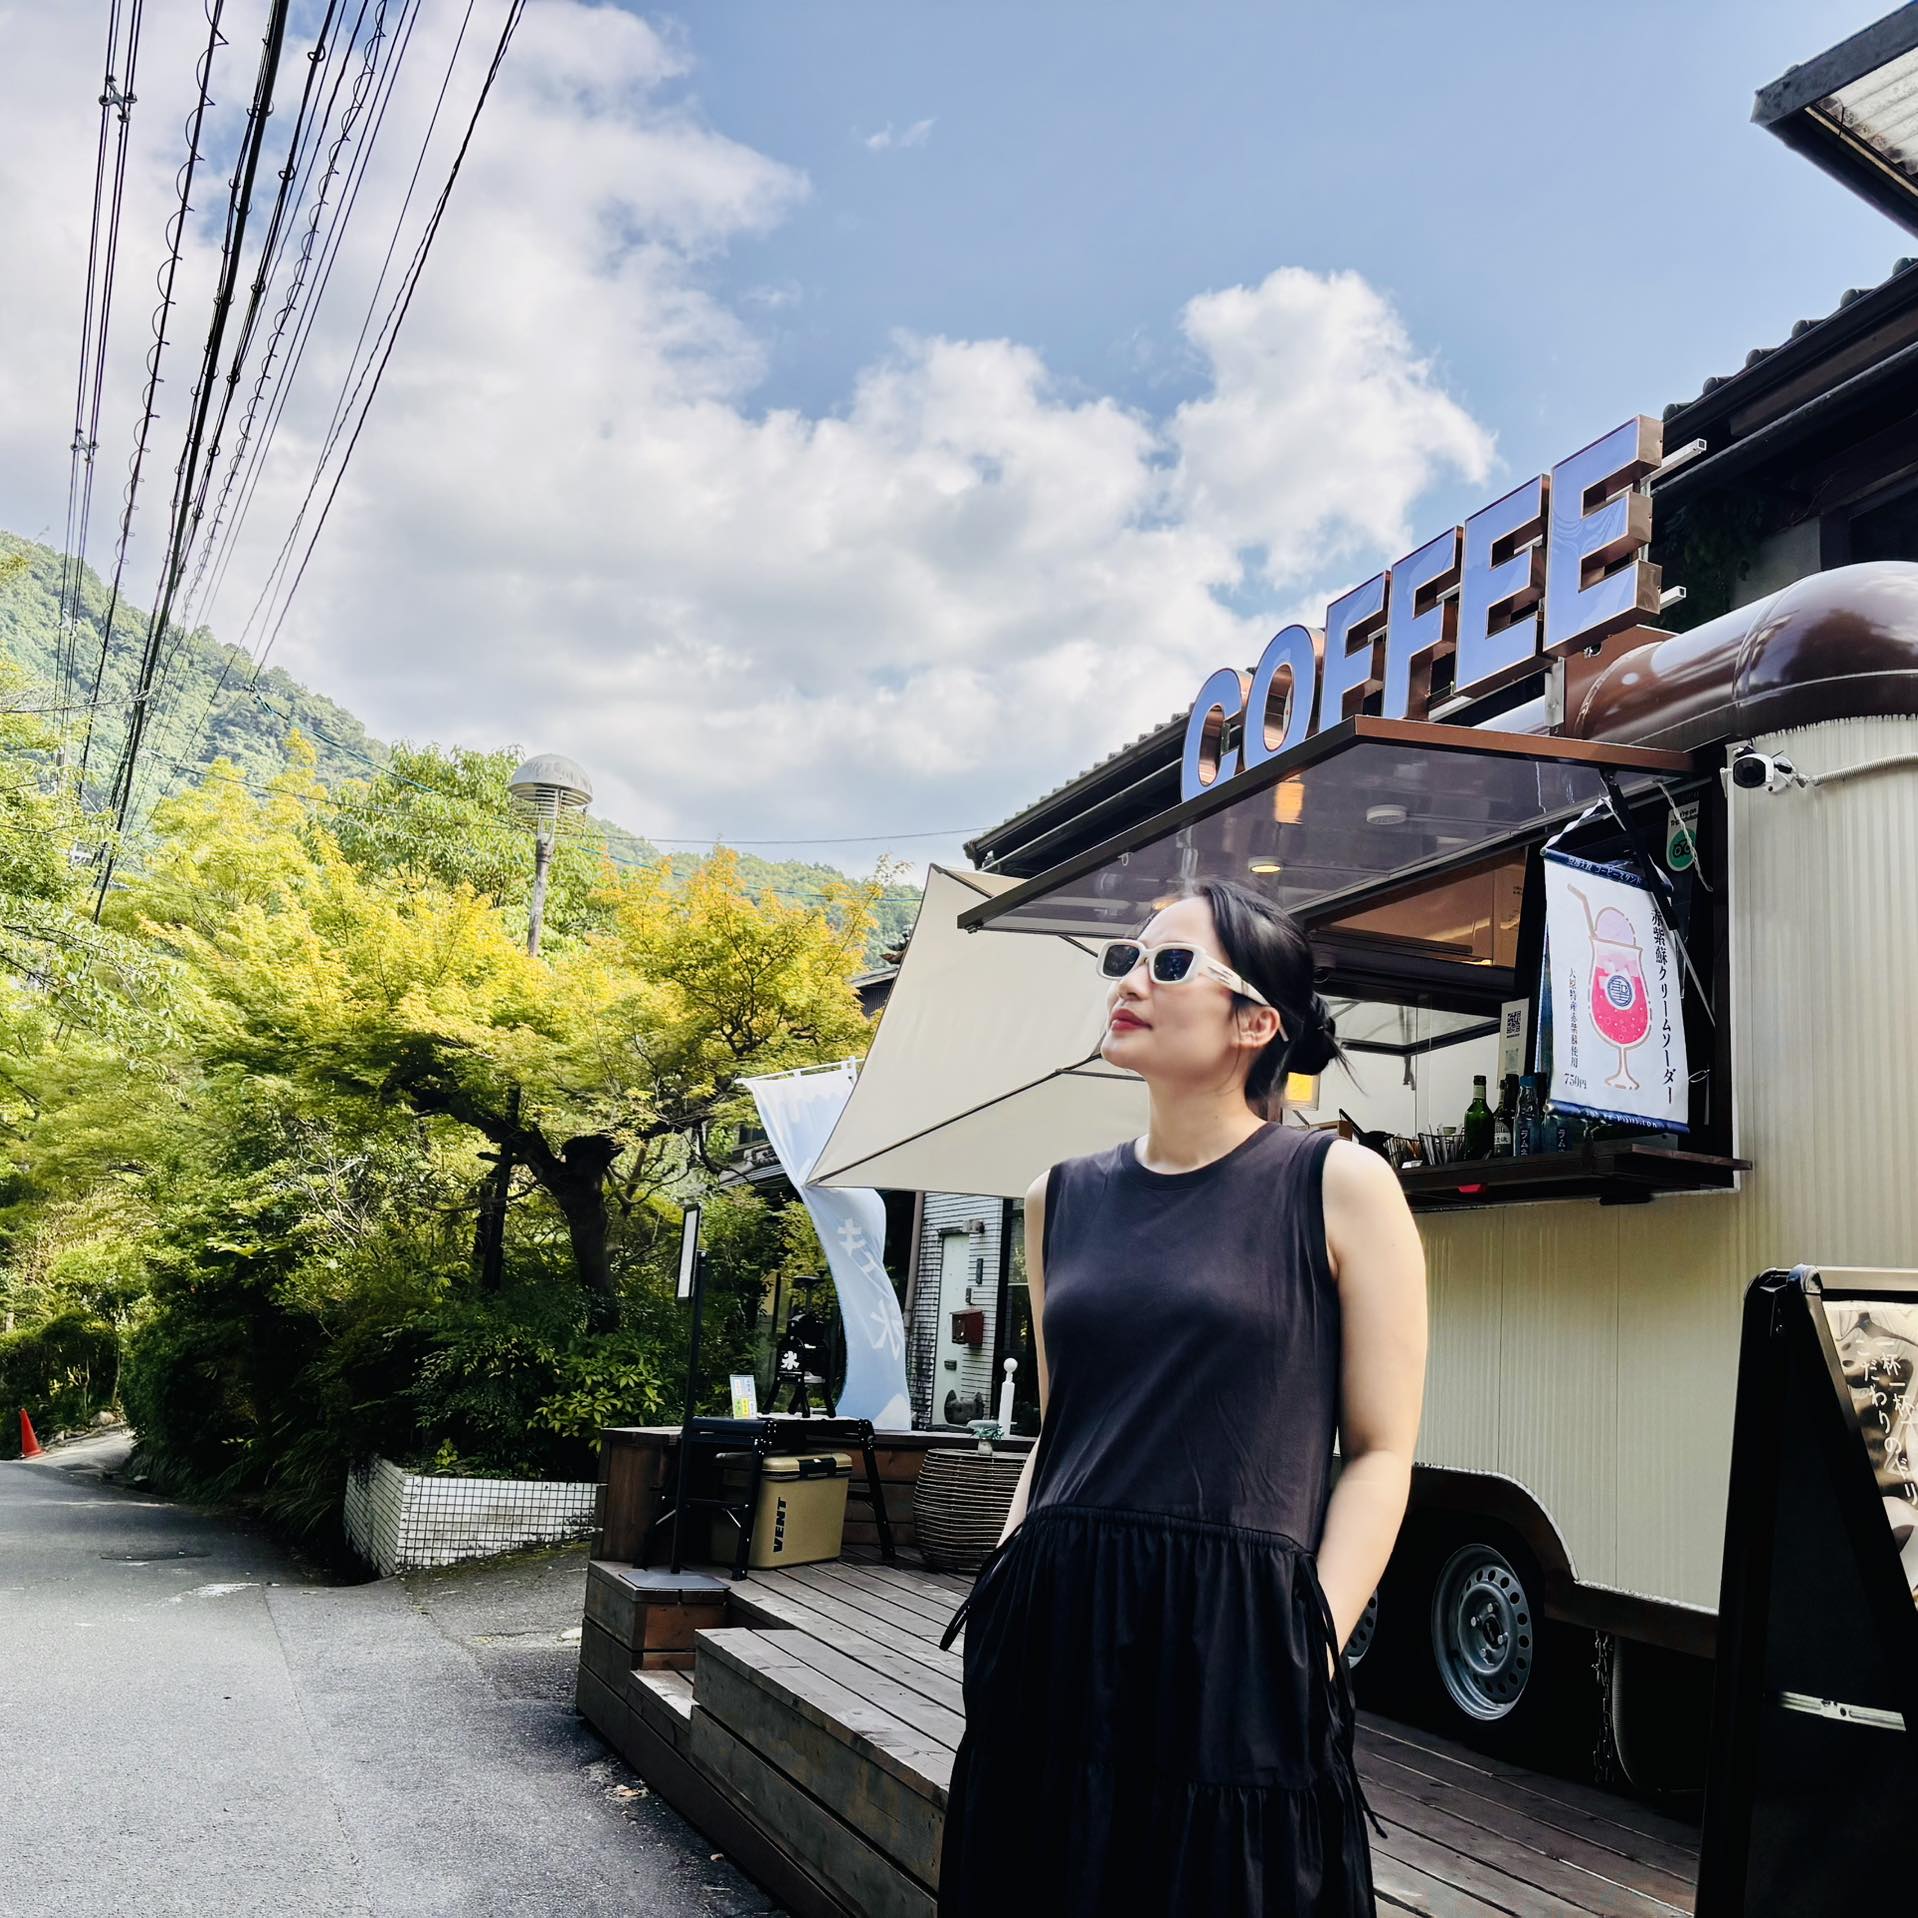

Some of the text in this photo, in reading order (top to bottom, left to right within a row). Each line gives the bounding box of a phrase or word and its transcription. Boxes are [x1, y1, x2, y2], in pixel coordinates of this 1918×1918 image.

[1181, 414, 1663, 802] COFFEE
[1651, 909, 1676, 1104] 赤紫蘇クリームソーダー
[1564, 1072, 1587, 1089] 750円
[1558, 1129, 1566, 1152] ラム
[781, 1350, 800, 1370] 氷
[772, 1496, 788, 1553] VENT
